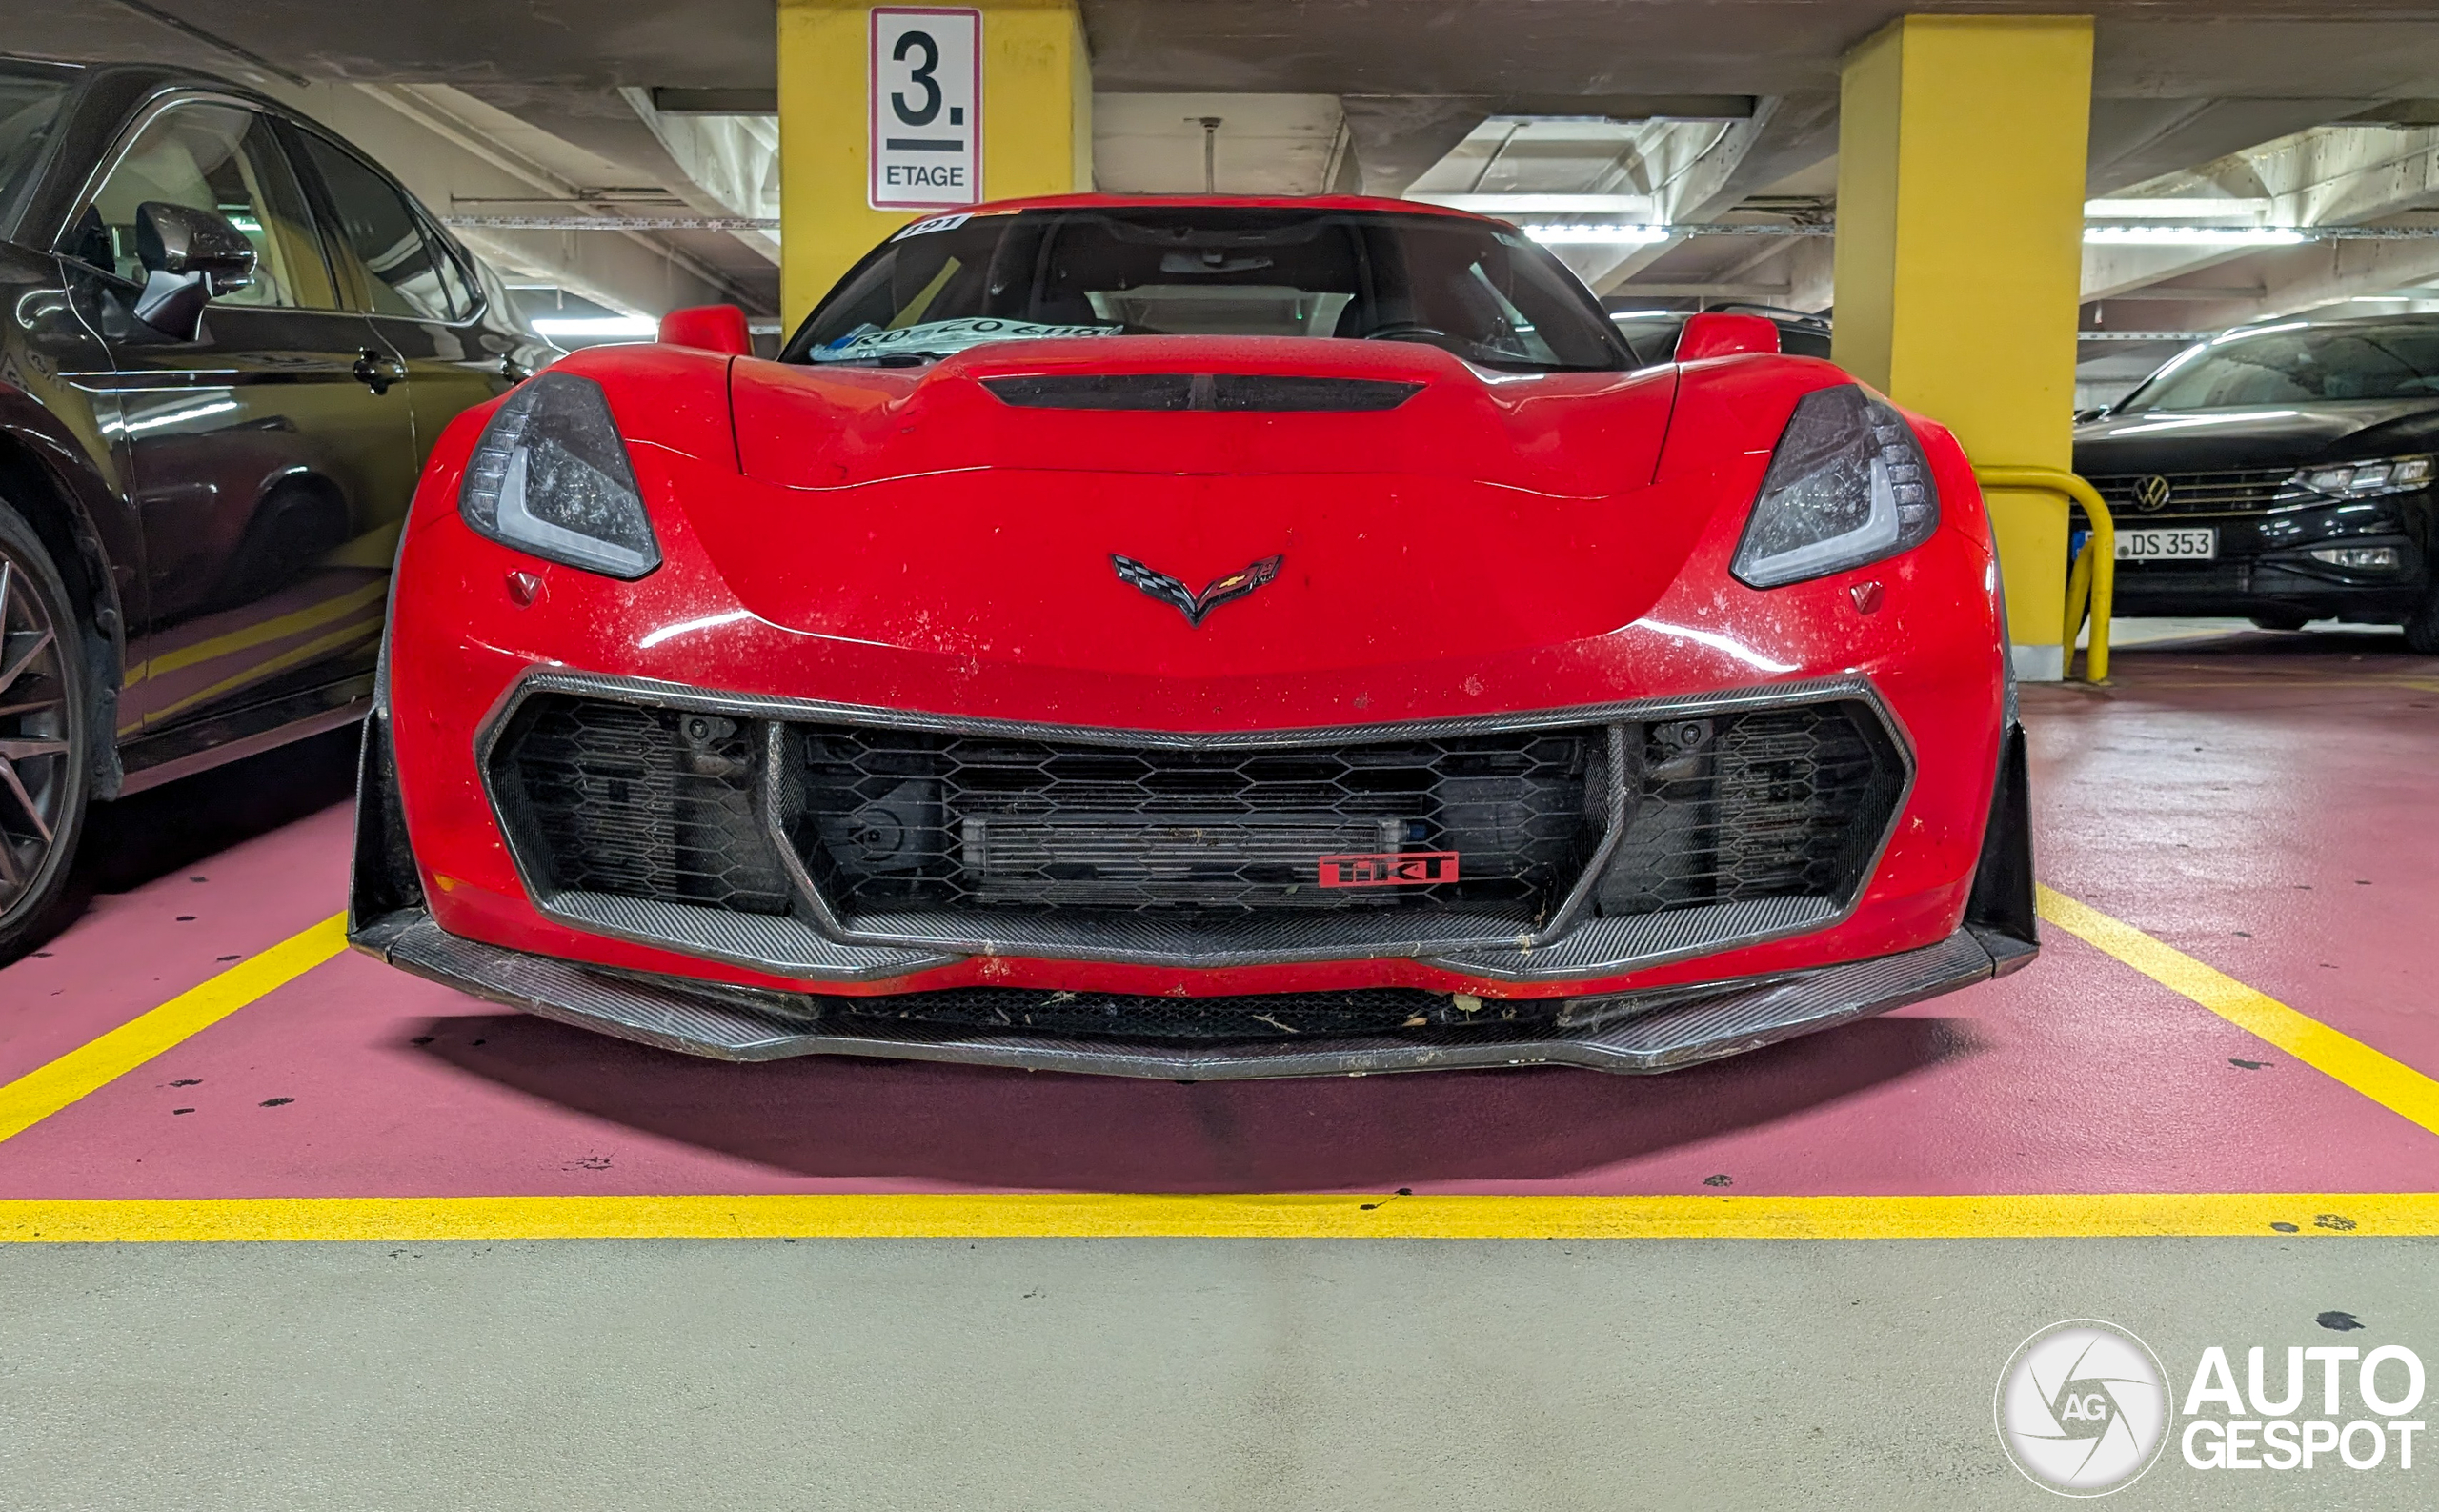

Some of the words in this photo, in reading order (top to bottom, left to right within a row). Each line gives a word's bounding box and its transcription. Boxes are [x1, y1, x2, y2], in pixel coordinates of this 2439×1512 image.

[891, 30, 964, 127] 3.
[886, 165, 964, 187] ETAGE
[905, 215, 963, 236] 191
[2131, 534, 2160, 555] DS
[2166, 533, 2209, 554] 353
